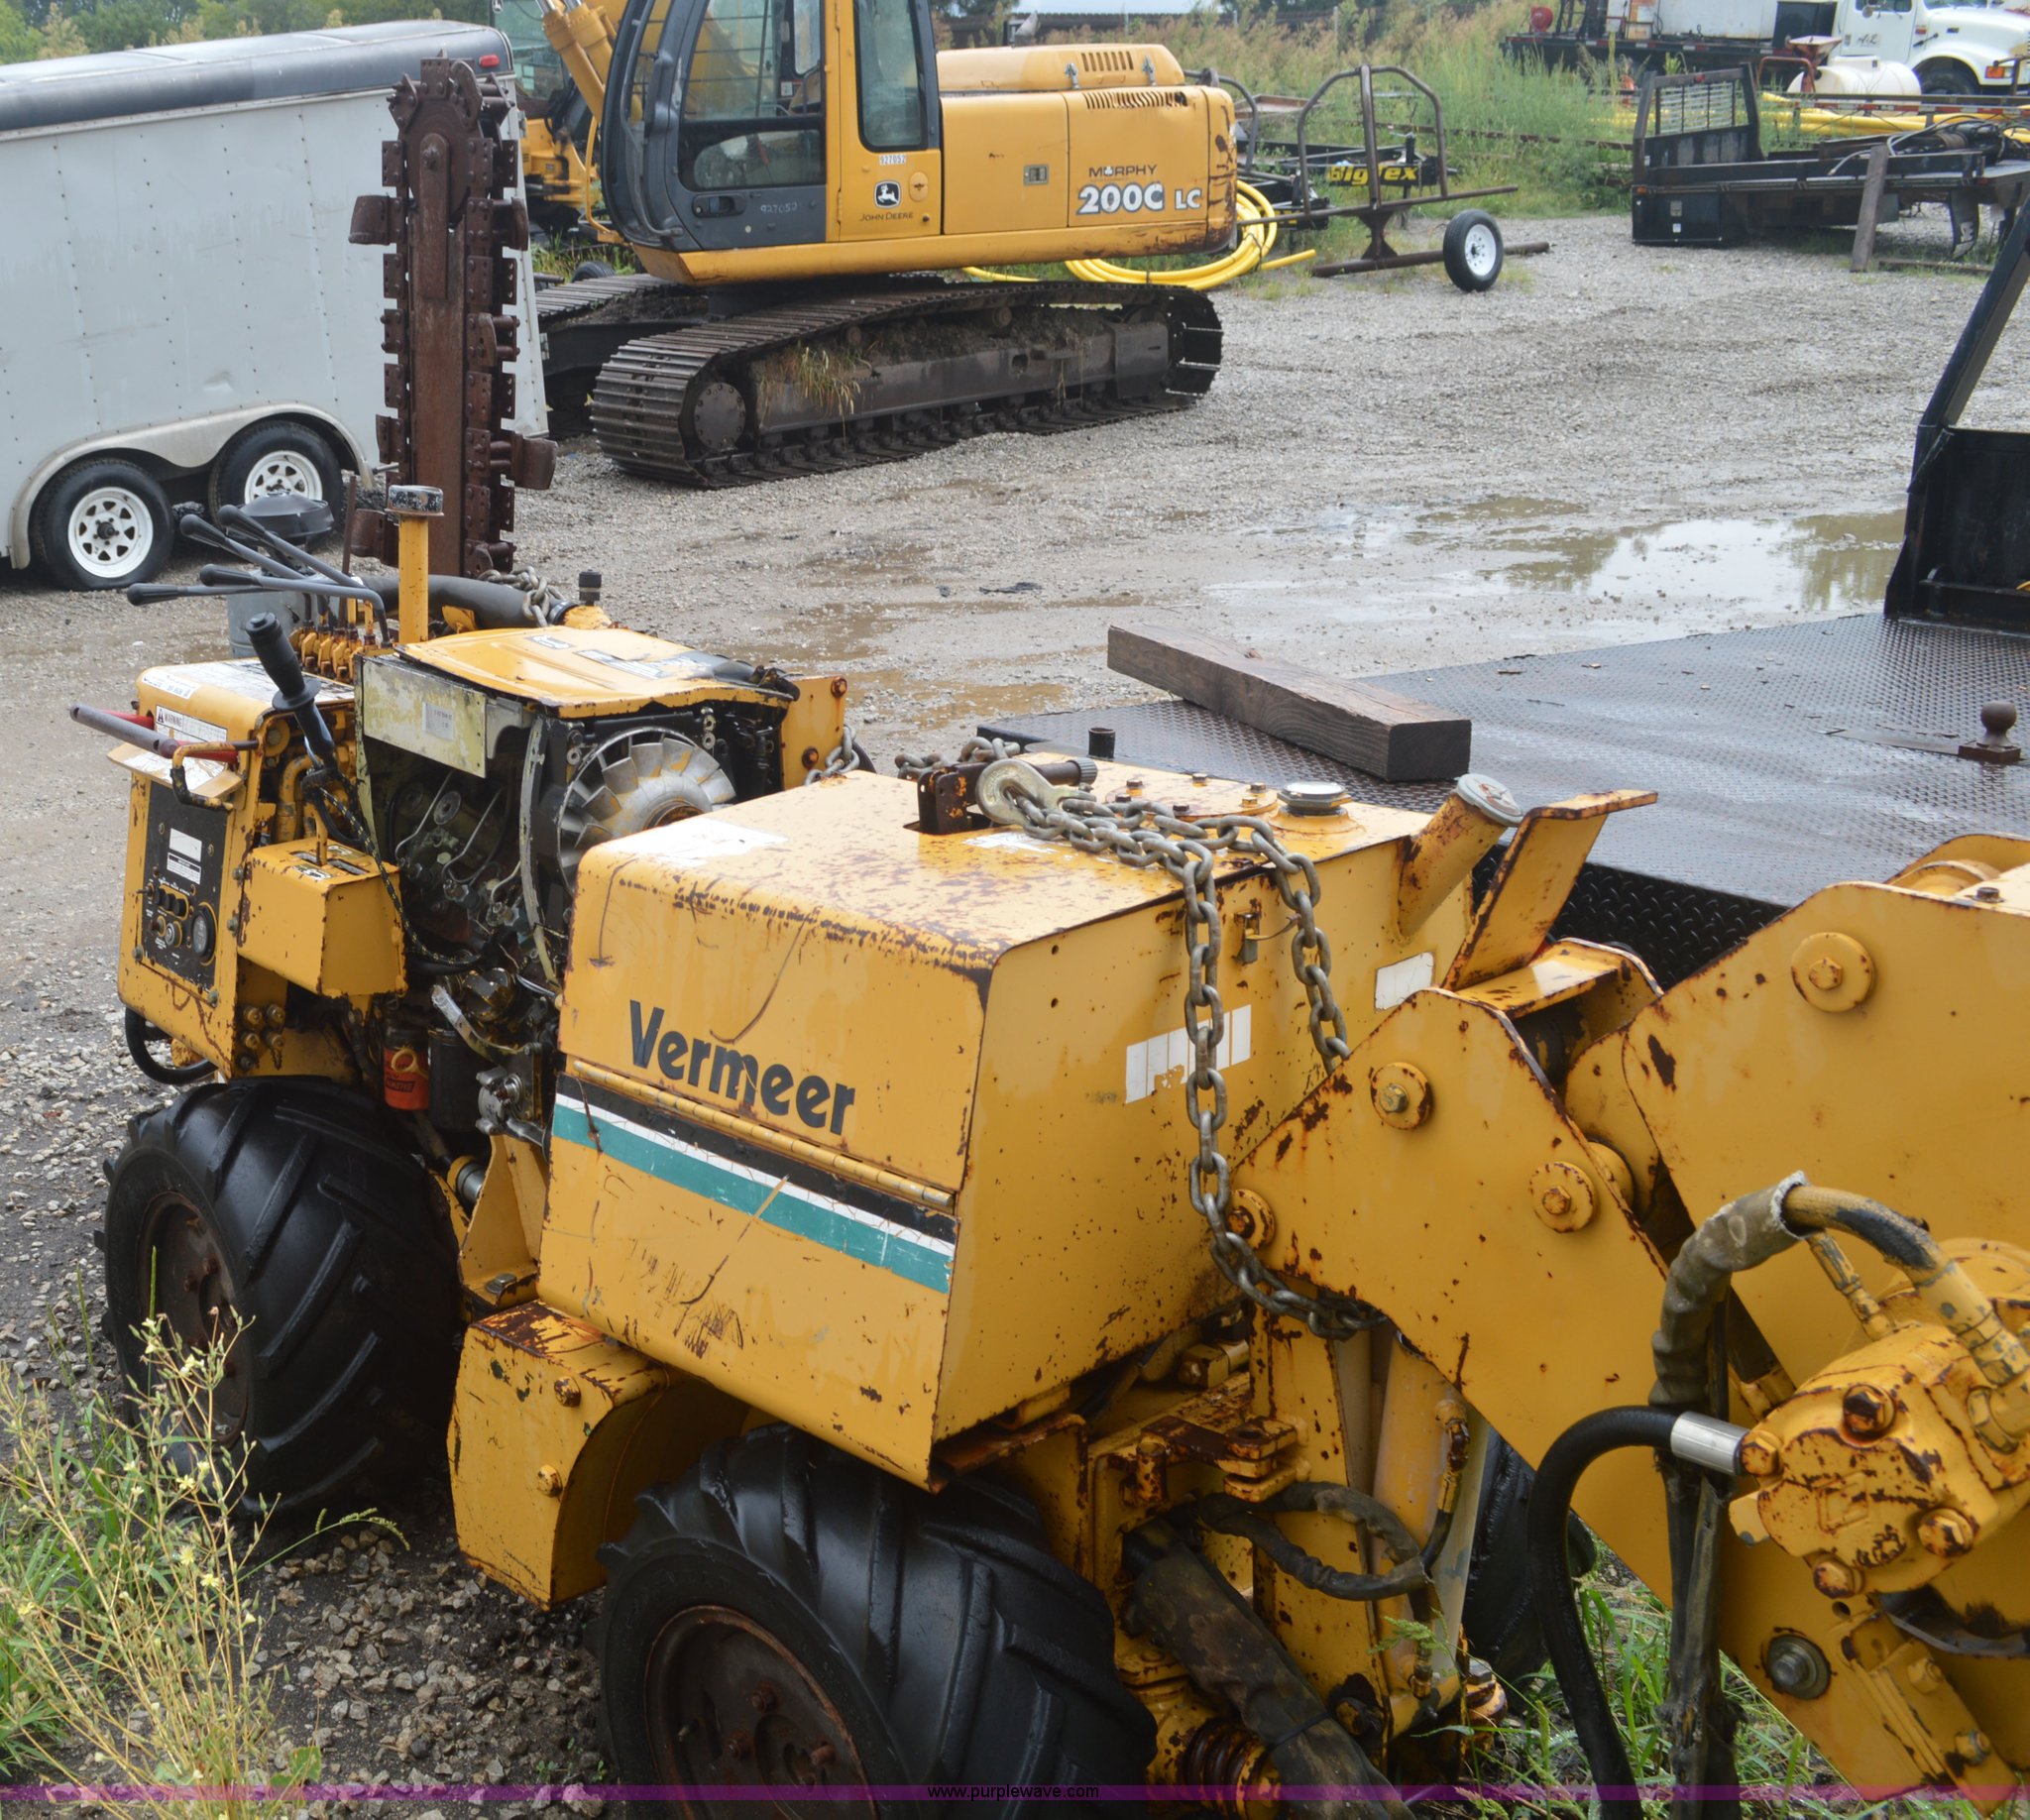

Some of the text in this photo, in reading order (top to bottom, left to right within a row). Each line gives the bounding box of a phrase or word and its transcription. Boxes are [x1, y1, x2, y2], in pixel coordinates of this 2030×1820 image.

[760, 201, 798, 215] 927052
[1076, 181, 1202, 215] 200C LC
[859, 211, 914, 222] JOHN DEERE
[629, 999, 855, 1136] Vermeer
